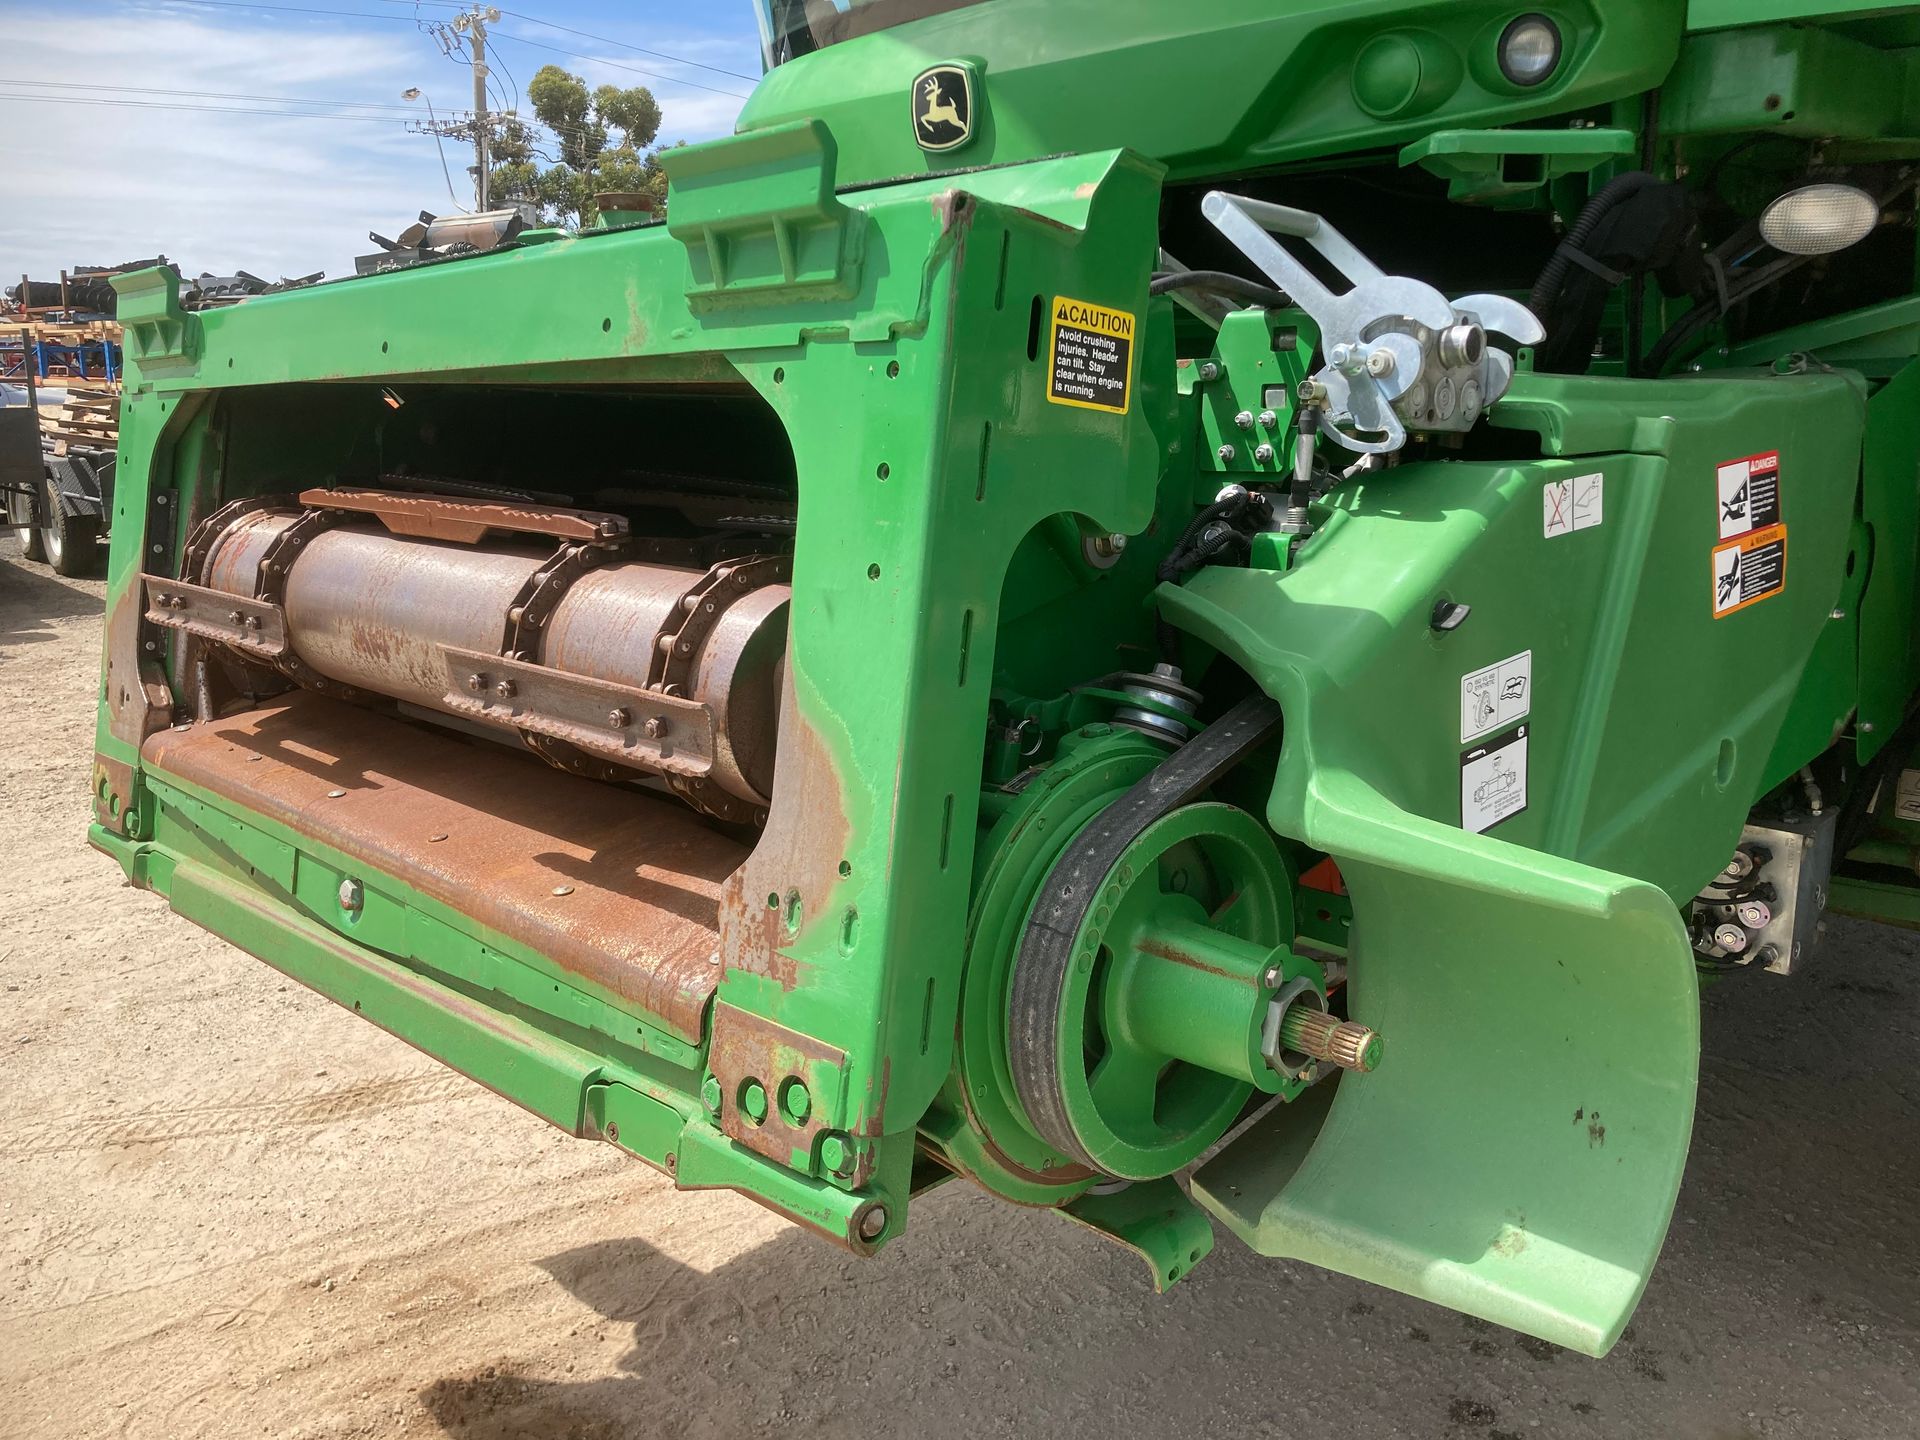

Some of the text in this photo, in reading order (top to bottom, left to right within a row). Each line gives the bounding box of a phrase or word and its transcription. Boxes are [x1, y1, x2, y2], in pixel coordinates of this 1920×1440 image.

[1070, 306, 1131, 334] CAUTION
[1059, 328, 1116, 352] Avoid crushing
[1058, 341, 1119, 363] injuries. Header
[1057, 356, 1106, 375] can tilt. Stay
[1055, 380, 1095, 399] is running.
[1056, 368, 1123, 390] clear when engine
